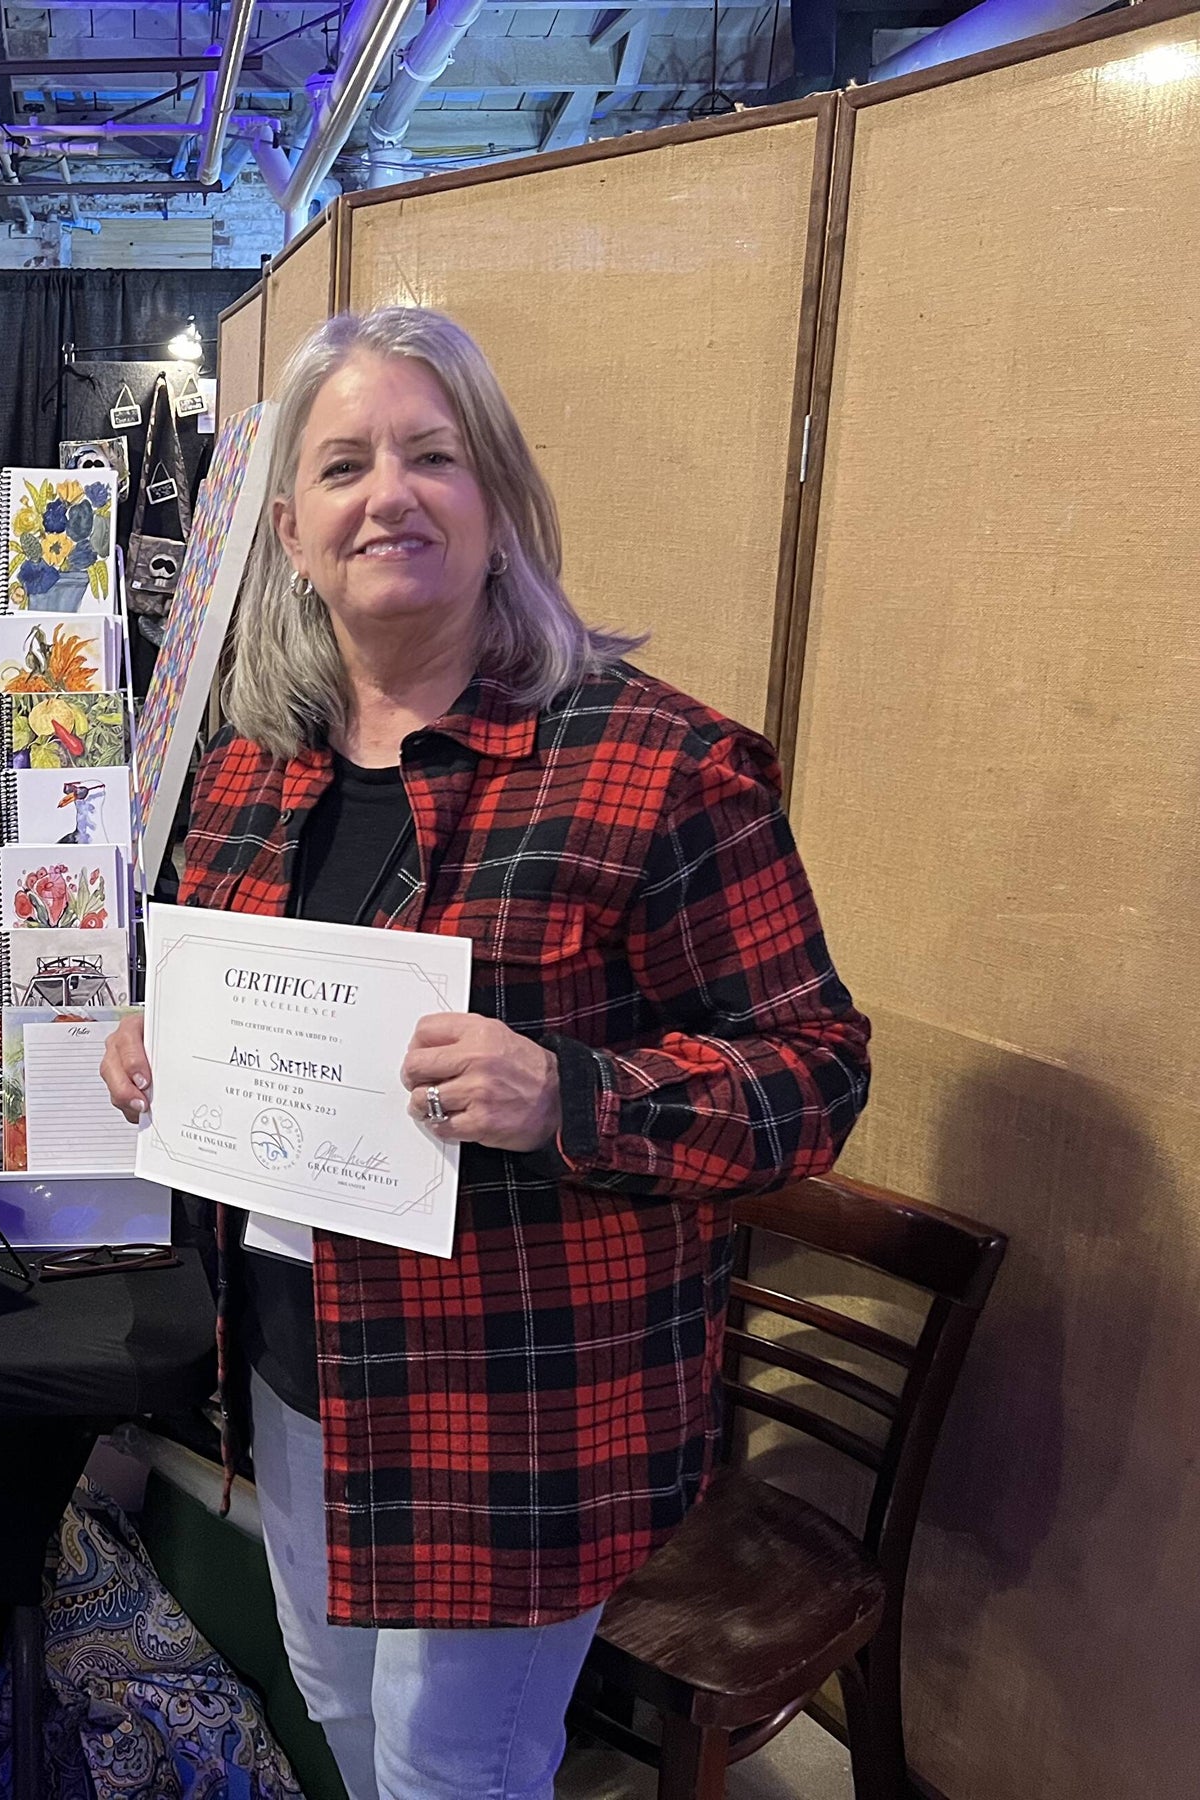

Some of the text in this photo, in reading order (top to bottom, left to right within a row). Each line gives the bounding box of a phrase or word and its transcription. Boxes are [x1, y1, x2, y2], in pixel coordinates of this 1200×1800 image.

[224, 967, 360, 1005] CERTIFICATE
[232, 995, 338, 1018] OF EXCELLENCE
[244, 1021, 285, 1035] CERTIFICATE
[294, 1029, 327, 1041] AWARDED
[268, 1052, 342, 1082] SNETHERN
[254, 1078, 304, 1095] BEST OF 2D
[225, 1086, 337, 1116] ART OF THE OZARKS 2023
[307, 1161, 400, 1187] GRACE HUCKFELDT
